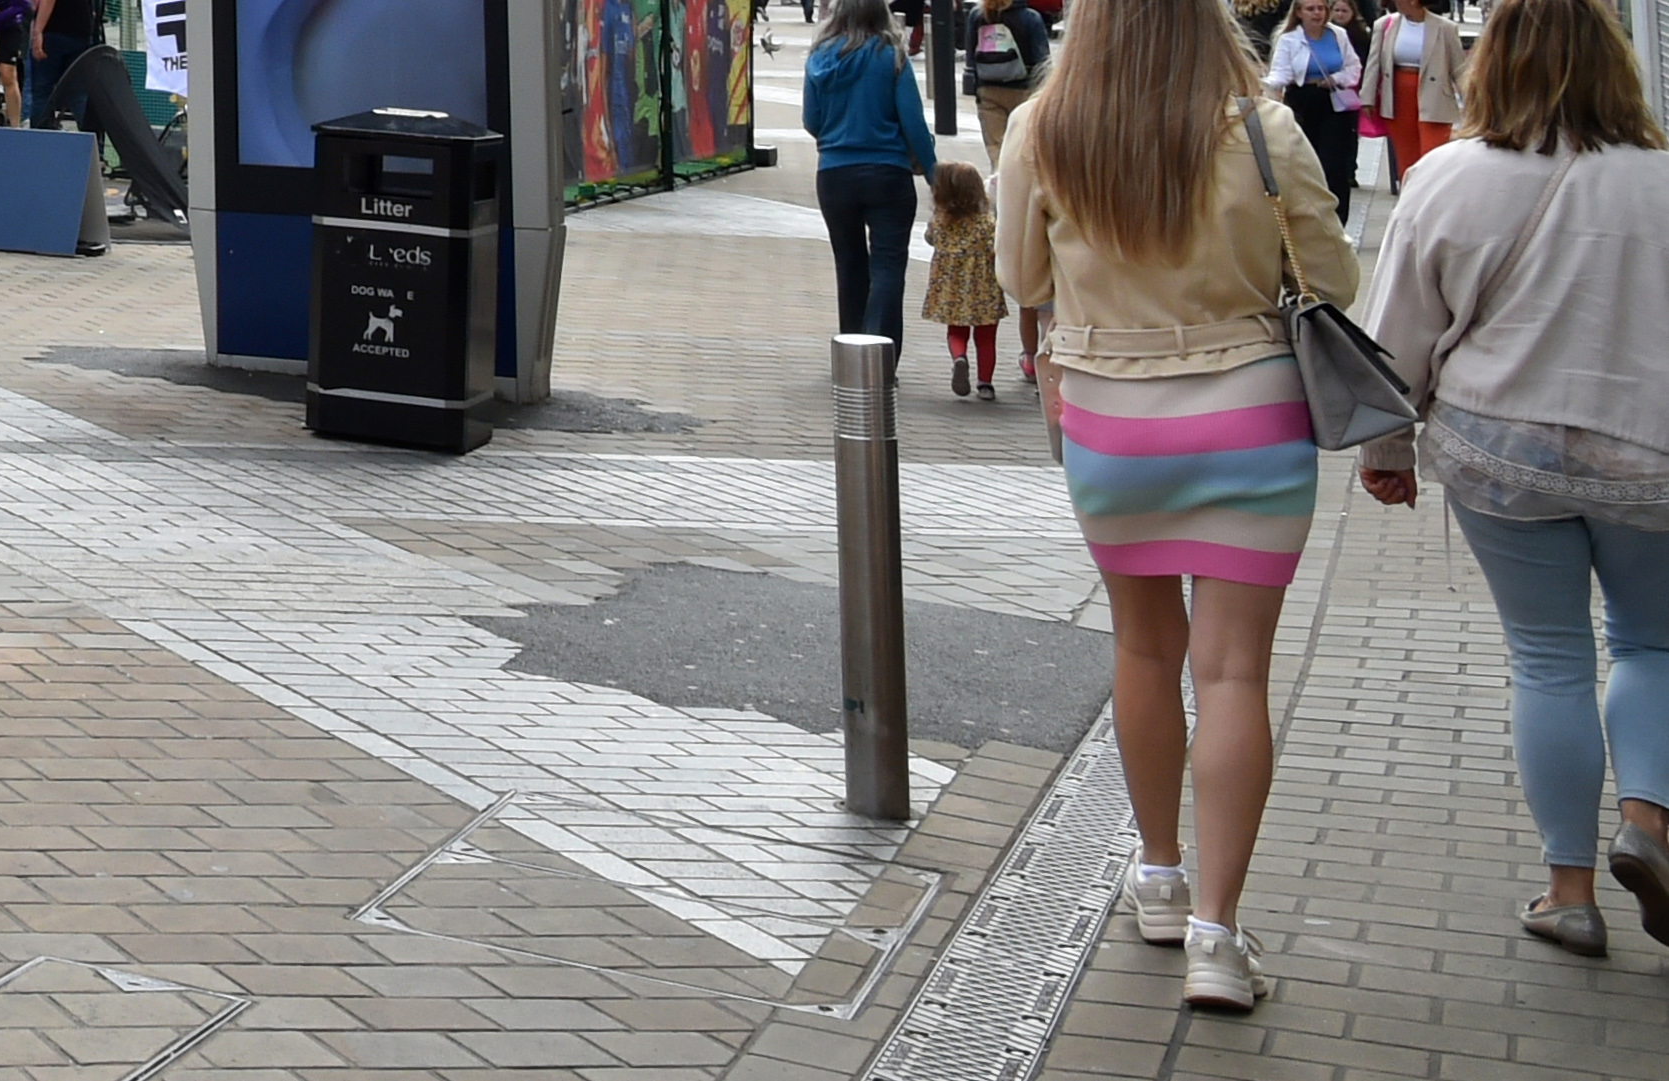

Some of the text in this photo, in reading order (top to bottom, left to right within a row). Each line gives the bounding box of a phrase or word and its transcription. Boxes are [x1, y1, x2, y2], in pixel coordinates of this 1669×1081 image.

[361, 197, 413, 218] Litter
[369, 244, 432, 266] Leds
[351, 285, 414, 301] DOG WAE
[352, 343, 410, 358] ACCEPTED
